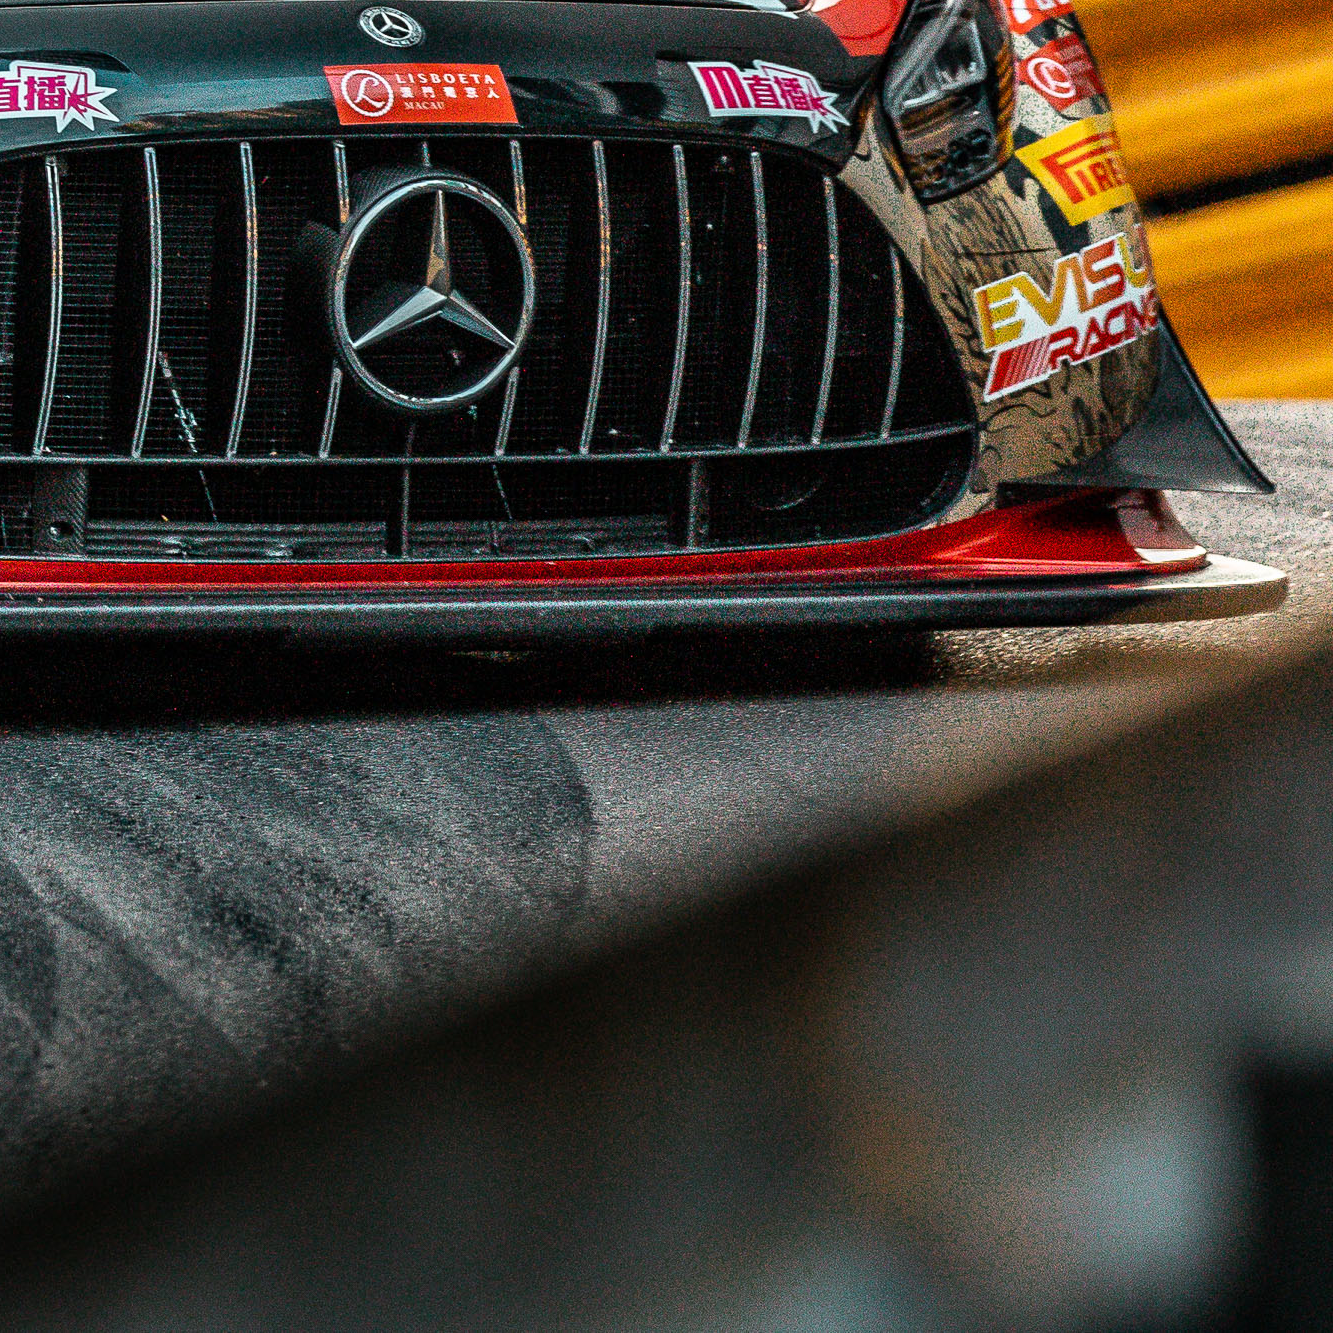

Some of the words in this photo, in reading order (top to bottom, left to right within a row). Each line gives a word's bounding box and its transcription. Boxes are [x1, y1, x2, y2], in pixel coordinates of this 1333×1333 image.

[394, 72, 497, 86] LISBOETA
[403, 100, 446, 111] MACAU
[974, 223, 1154, 349] EVISU
